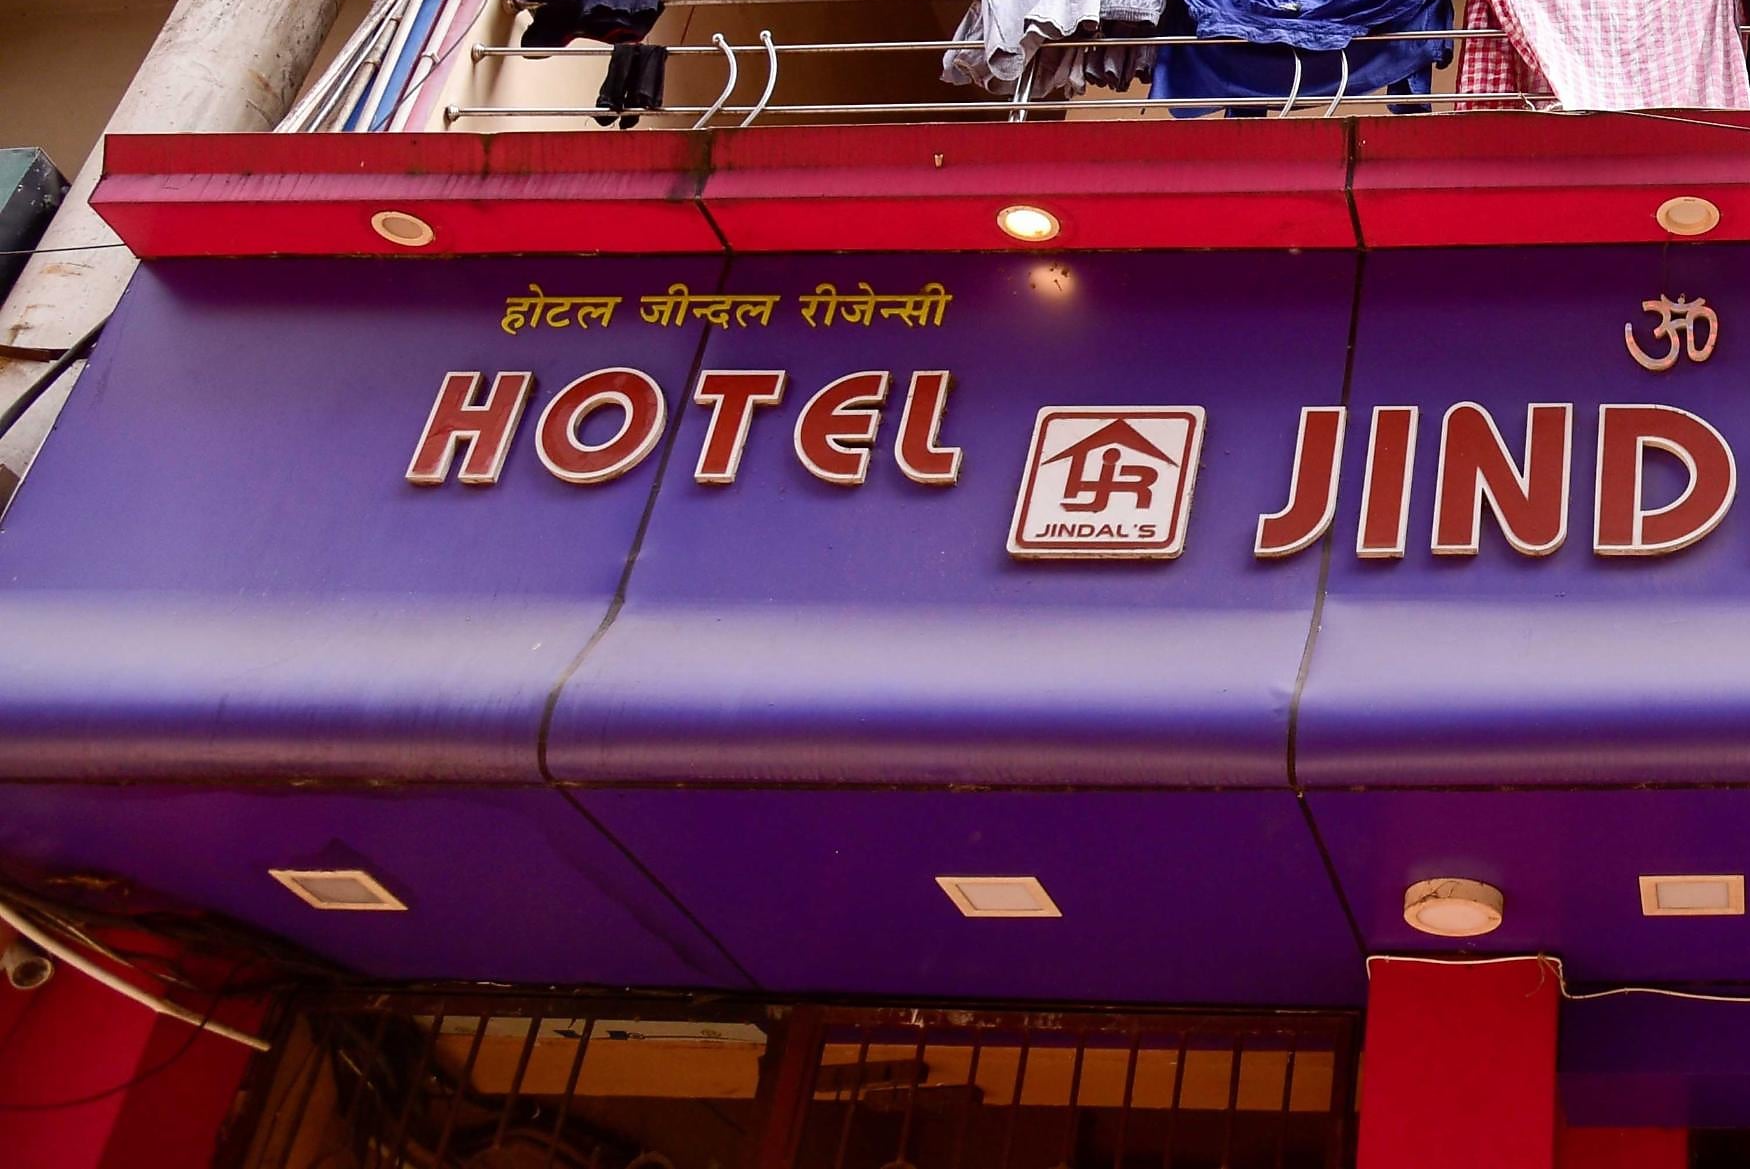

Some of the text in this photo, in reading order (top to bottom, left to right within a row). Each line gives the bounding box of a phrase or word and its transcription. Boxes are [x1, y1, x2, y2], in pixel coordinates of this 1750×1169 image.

[502, 282, 953, 335] होटल जीन्दल रीजेन्सी
[406, 368, 962, 485] HOTEL
[1035, 523, 1157, 539] JINDAL'S
